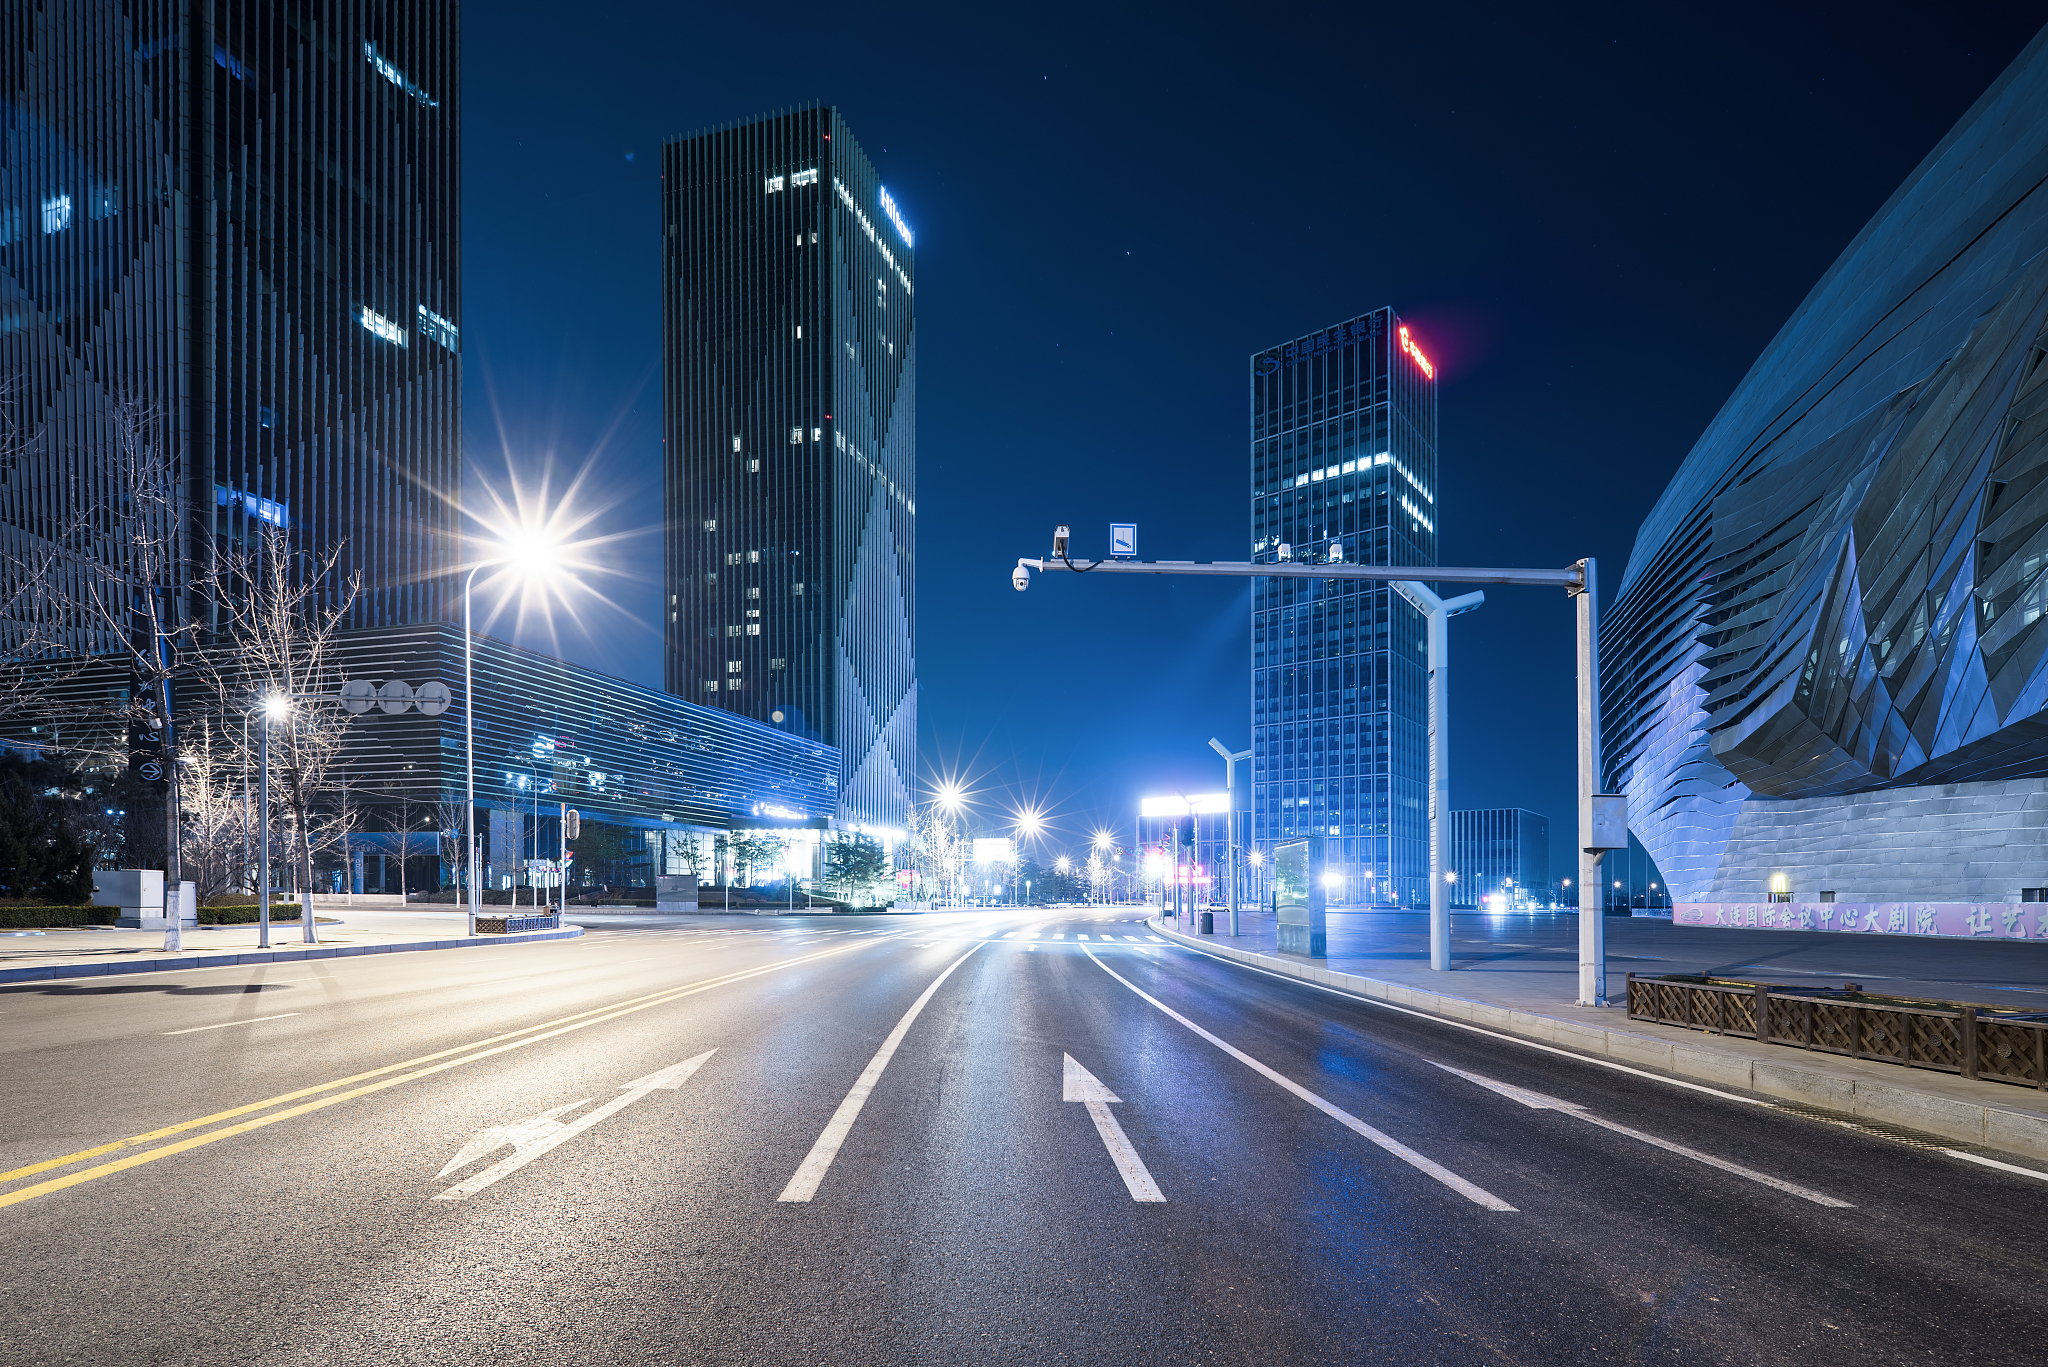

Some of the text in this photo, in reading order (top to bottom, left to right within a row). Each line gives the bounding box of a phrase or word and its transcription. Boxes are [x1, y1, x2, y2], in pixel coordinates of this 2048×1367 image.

[880, 185, 912, 249] Hilton
[1285, 314, 1384, 359] 中国民生银行
[1285, 328, 1383, 368] CHINA MINSHENG BANK
[1715, 903, 1939, 934] 大连国际会议中心大剧院
